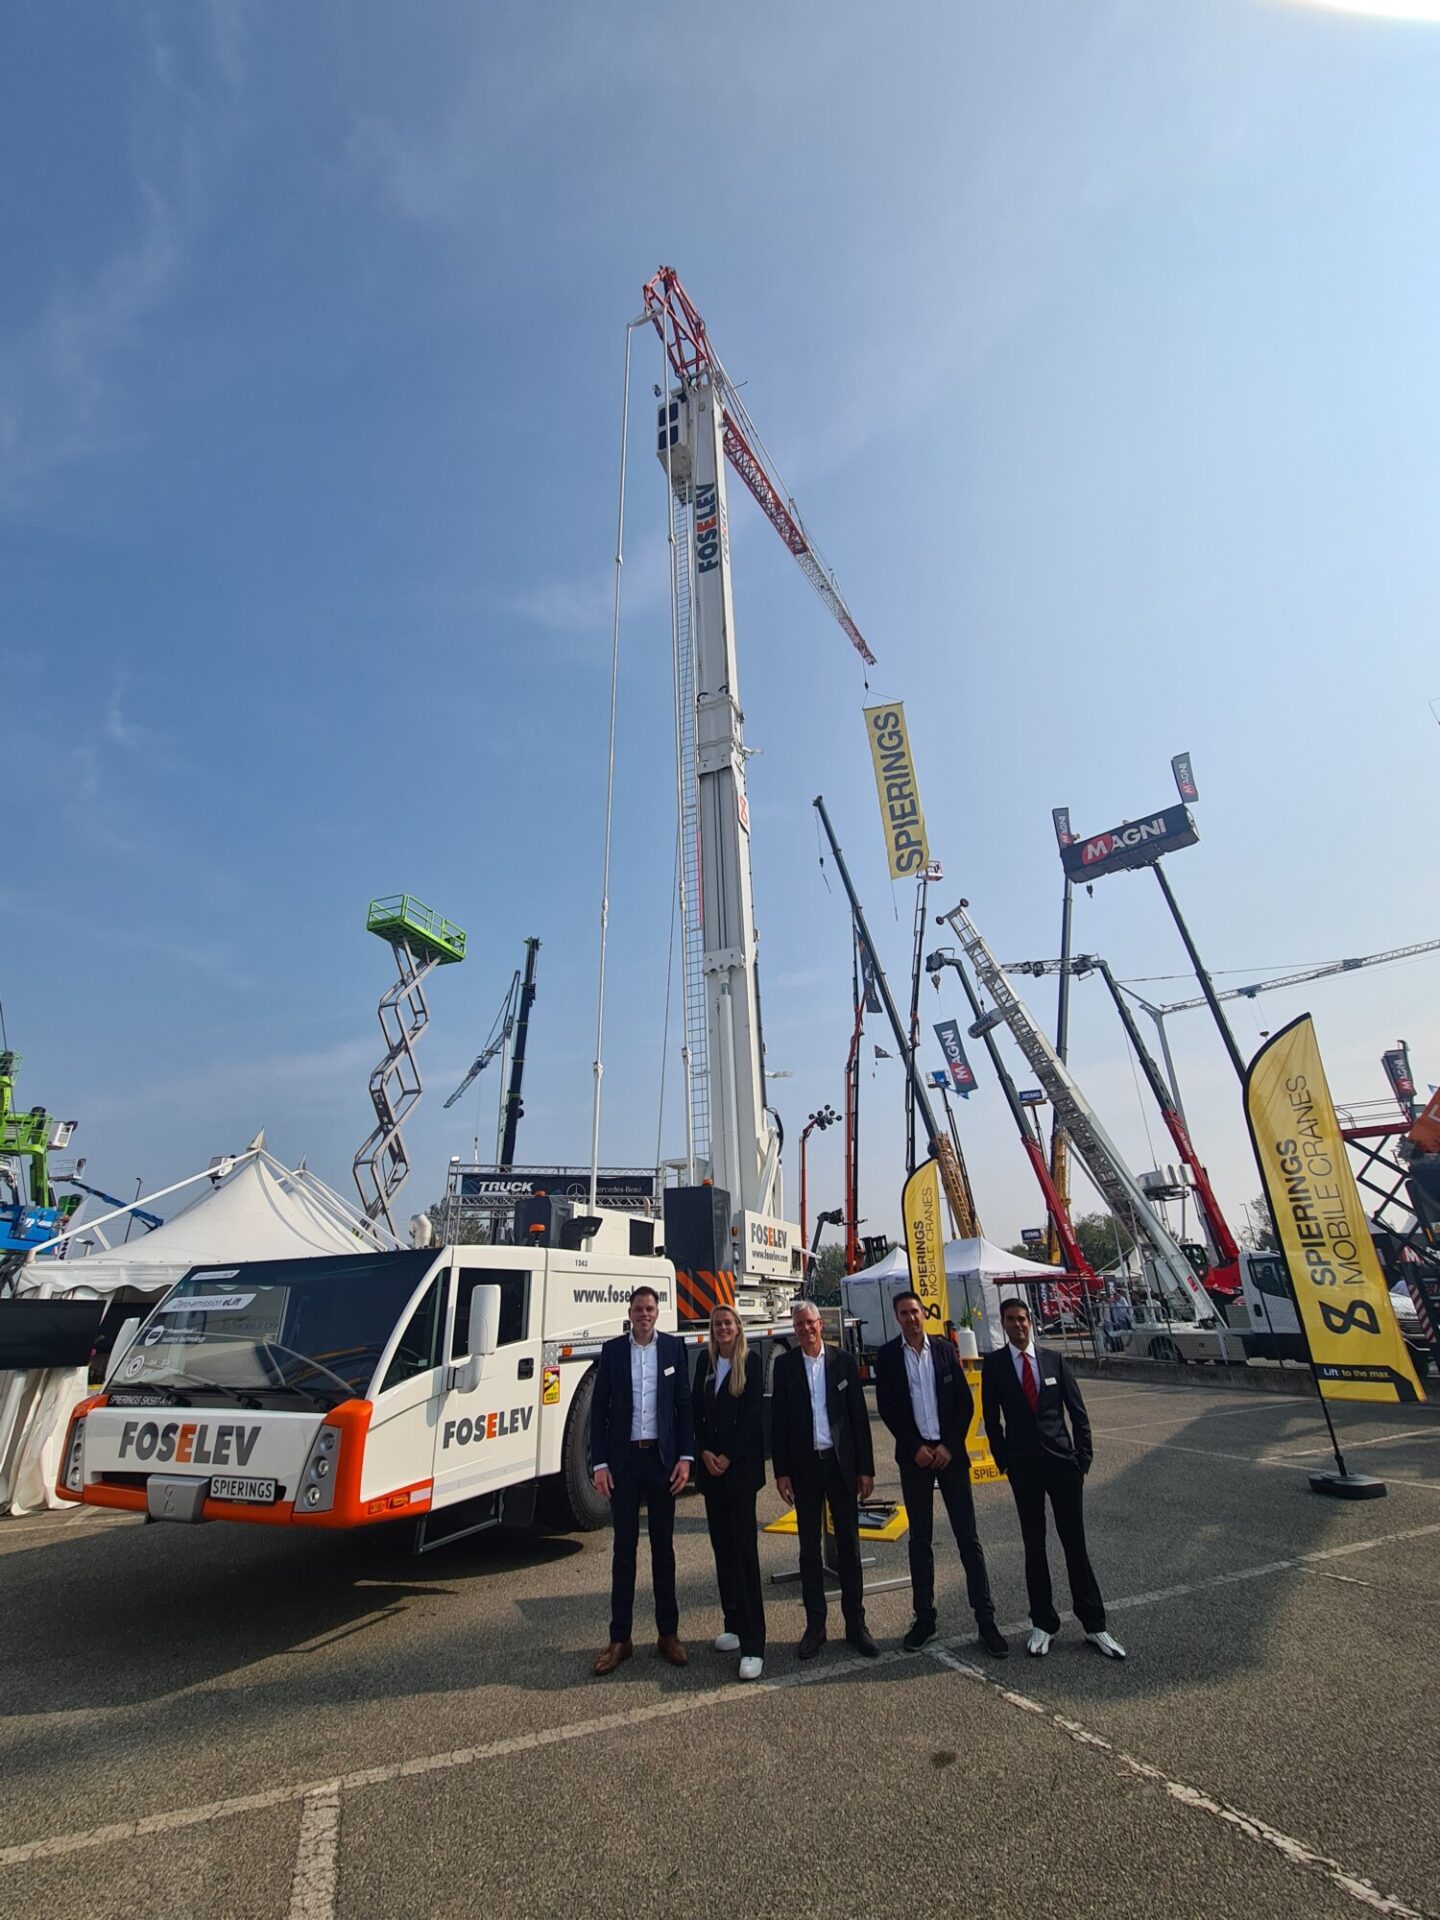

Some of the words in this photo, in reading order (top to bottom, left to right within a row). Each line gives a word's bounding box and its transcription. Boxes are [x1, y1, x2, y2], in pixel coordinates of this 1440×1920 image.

[696, 483, 719, 574] FOSELEV
[873, 711, 924, 873] SPIERINGS
[1086, 818, 1168, 861] MAGNI
[941, 1029, 970, 1081] MAGNI
[1286, 1074, 1333, 1179] CRANES
[478, 1181, 534, 1193] TRUCK
[596, 1185, 642, 1193] ercedes-Benz
[751, 1222, 787, 1249] FOSELEV
[922, 1186, 935, 1242] CRANES
[1276, 1138, 1337, 1287] SPIERINGS
[1314, 1183, 1366, 1285] MOBILE
[914, 1220, 929, 1297] SPIERINGS
[926, 1244, 938, 1297] MOBILE
[573, 1284, 668, 1303] www.fosem
[1323, 1367, 1339, 1377] Lift
[1342, 1369, 1352, 1377] to
[1353, 1369, 1368, 1378] the
[117, 1421, 262, 1467] FOSELEV
[442, 1405, 534, 1450] FOSELEV
[212, 1479, 273, 1499] SPIERINGS
[973, 1467, 998, 1480] SPIE
